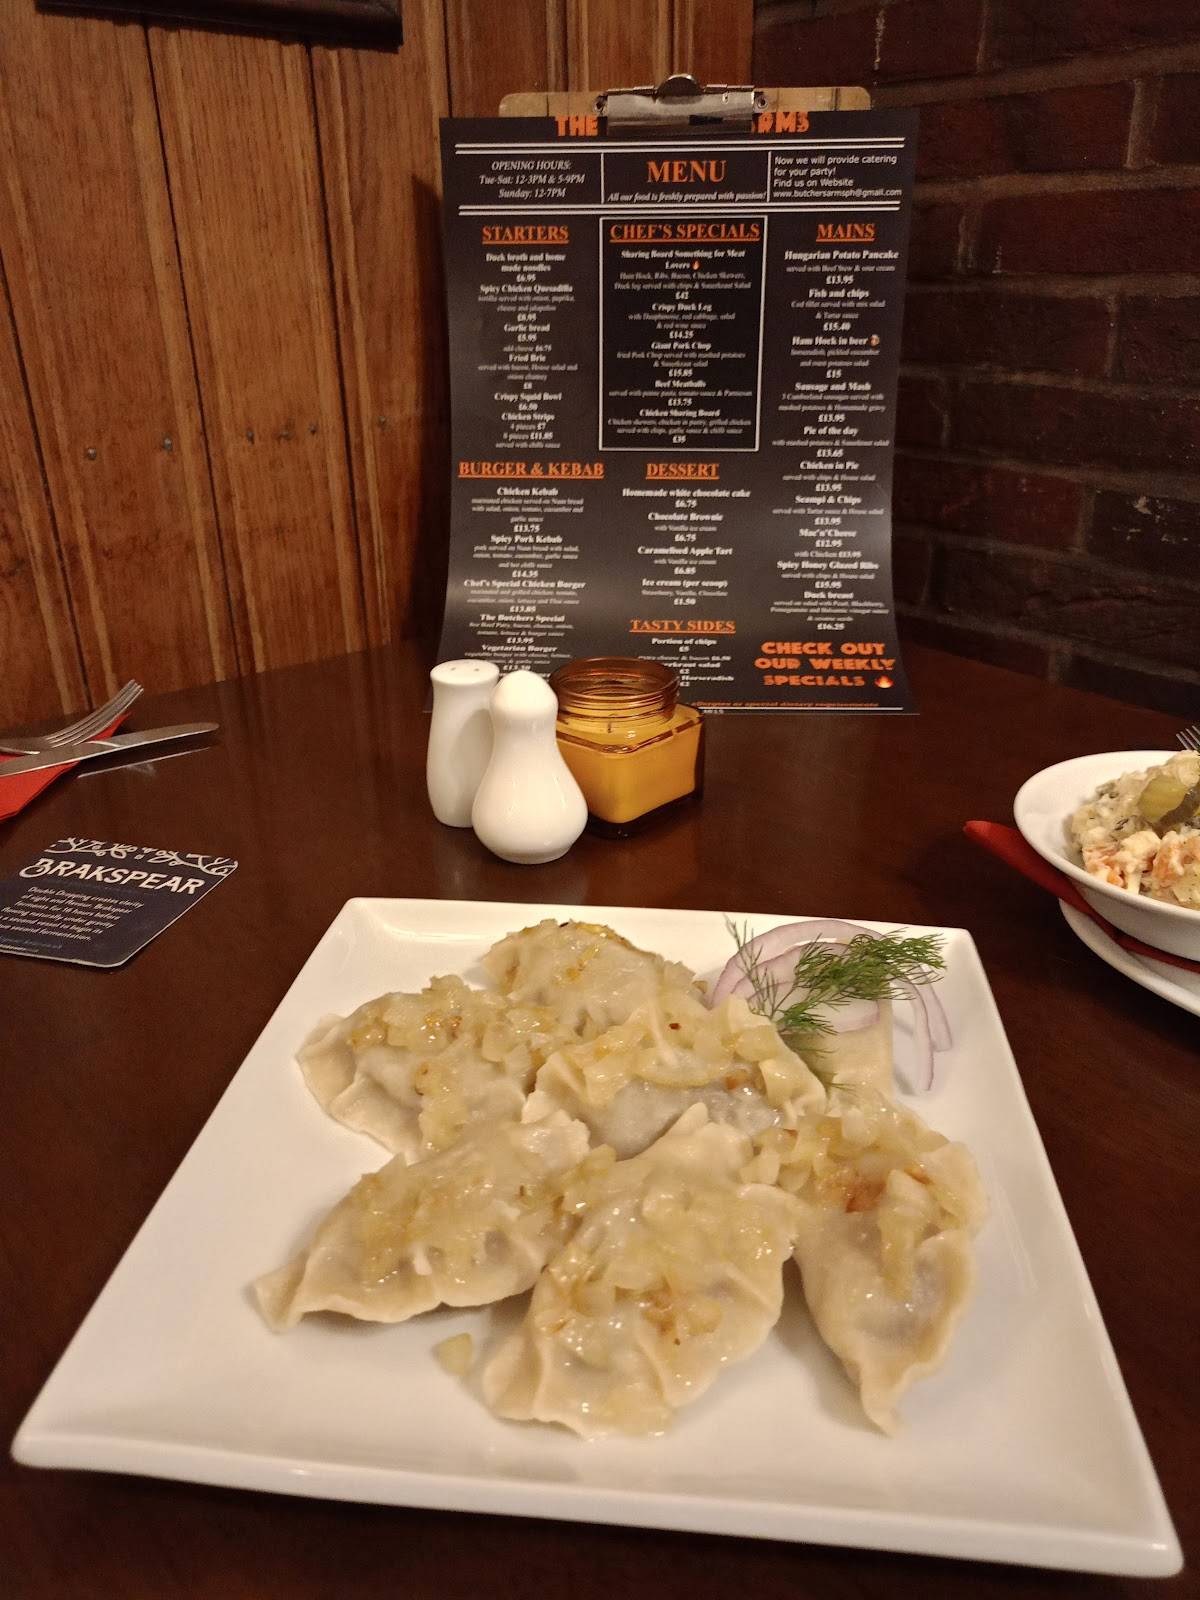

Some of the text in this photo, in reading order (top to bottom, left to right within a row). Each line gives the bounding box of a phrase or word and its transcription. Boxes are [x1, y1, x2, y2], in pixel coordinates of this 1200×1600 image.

[555, 114, 598, 136] THE
[752, 112, 809, 133] RMS
[492, 160, 571, 170] OPENING HOURS:
[774, 156, 793, 164] Now
[811, 156, 825, 164] will
[827, 156, 859, 165] provide
[862, 155, 897, 164] catering
[647, 160, 727, 182] MENU
[774, 168, 836, 177] for your party!
[480, 174, 585, 184] Tue-Sat: 12-3PM & 5-9PM
[773, 178, 791, 186] Find
[820, 178, 853, 186] Website
[535, 188, 566, 197] 12-7PM
[608, 193, 619, 201] All
[634, 193, 650, 202] food
[658, 192, 682, 202] freshly
[684, 192, 717, 202] prepared
[718, 192, 734, 200] with
[773, 189, 902, 198] www.butchersarmsph@gmail.com
[482, 226, 569, 244] STARTERS
[610, 224, 760, 242] CHEF'S SPECIALS
[816, 224, 875, 242] MAINS
[486, 253, 505, 261] Duck
[530, 253, 543, 261] and
[622, 250, 649, 259] Sharing
[651, 250, 673, 258] Board
[714, 250, 726, 258] for
[784, 249, 899, 261] Hungarian Potato Pancake
[502, 284, 532, 292] Chicken
[809, 289, 869, 299] Fish and chips
[678, 303, 696, 311] Duck
[529, 324, 550, 332] bread
[792, 336, 812, 345] Ham
[839, 336, 847, 345] in
[509, 354, 546, 362] Fried Brie
[655, 380, 670, 388] Beef
[830, 382, 846, 390] and
[804, 426, 858, 436] Pie of the day
[458, 461, 604, 479] BURGER & KEBAB
[800, 461, 859, 469] Chicken in Pie
[646, 463, 720, 479] DESSERT
[497, 487, 558, 496] Chicken Kebab
[623, 488, 667, 497] Homemade
[732, 490, 750, 498] cake
[648, 512, 688, 521] Chocolate
[491, 535, 512, 544] Spicy
[514, 535, 534, 543] Pork
[777, 561, 799, 570] Spicy
[804, 591, 825, 599] Duck
[629, 619, 736, 634] TASTY SIDES
[761, 642, 885, 655] CHECK OUT
[810, 658, 895, 671] WEEKLY
[763, 675, 865, 686] SPECIALS
[19, 858, 205, 895] BRAKSPEAR
